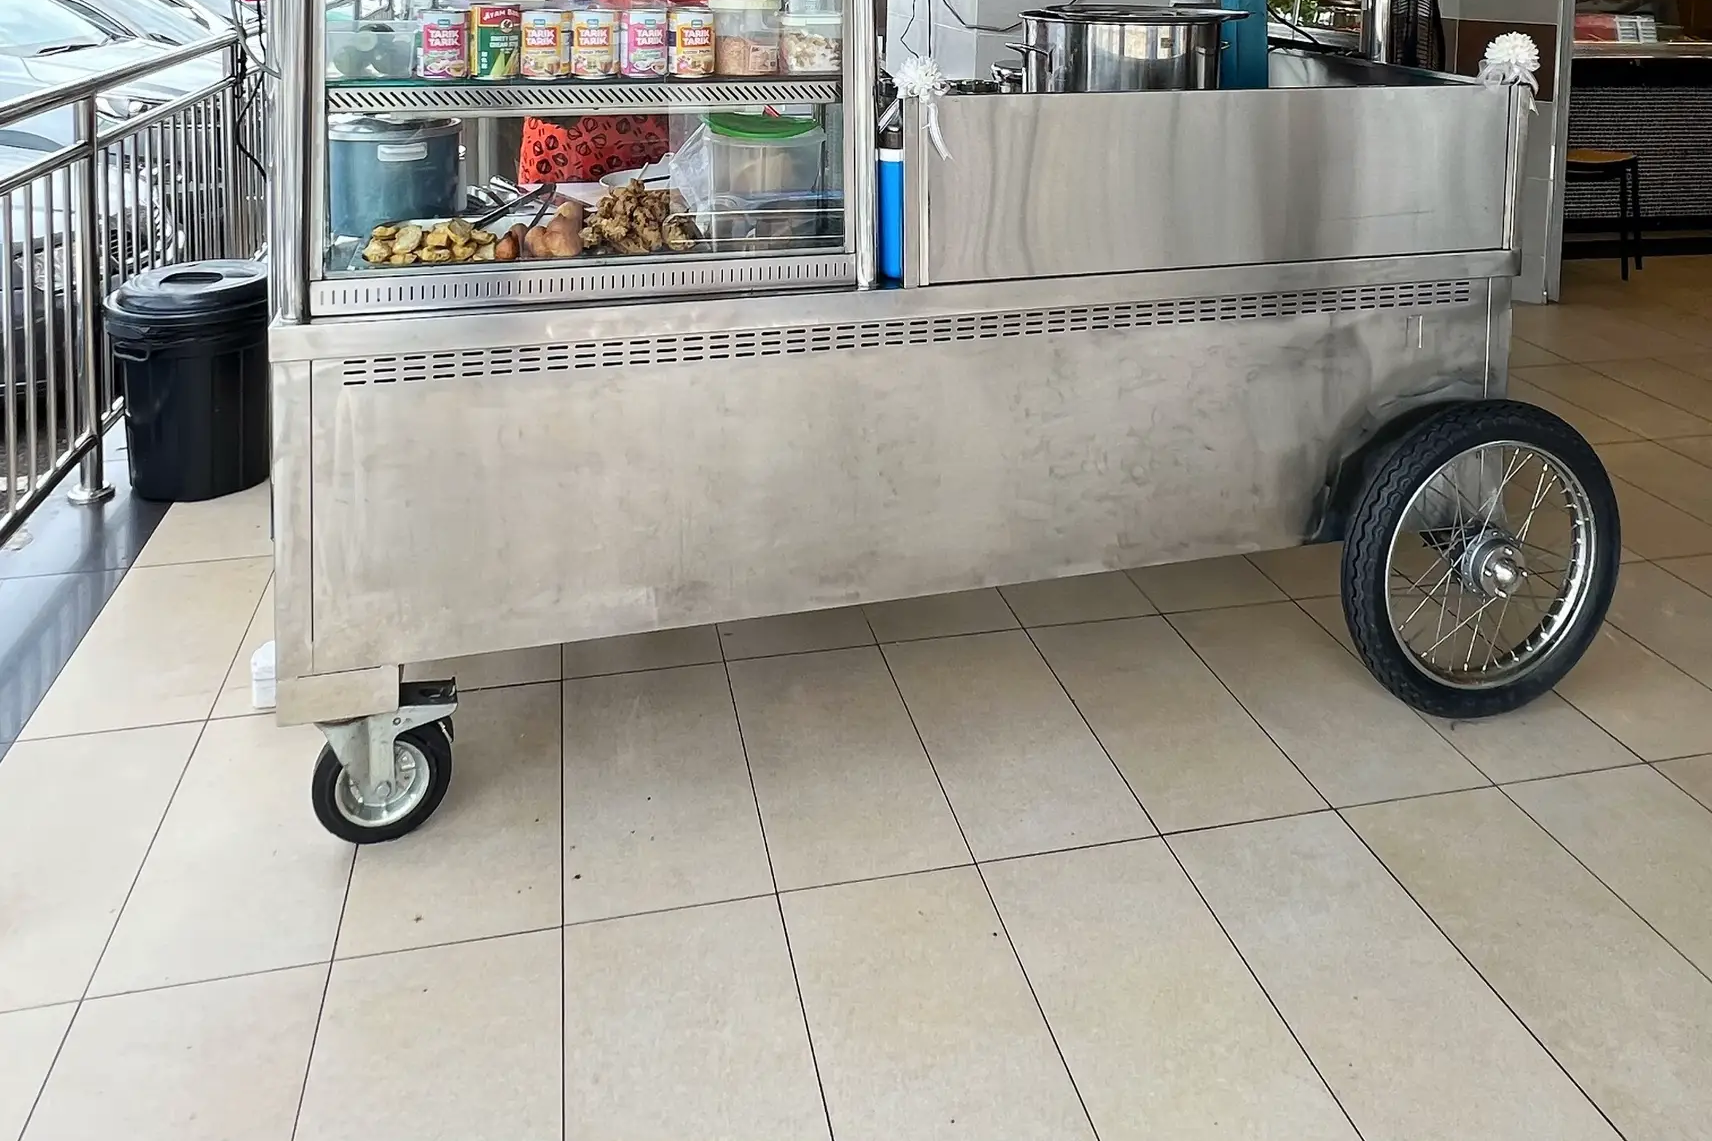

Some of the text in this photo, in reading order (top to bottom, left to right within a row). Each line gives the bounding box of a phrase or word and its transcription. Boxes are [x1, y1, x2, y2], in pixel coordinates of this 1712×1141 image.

[427, 29, 460, 38] TARIK
[525, 28, 555, 38] TARIK
[577, 28, 608, 38] TARIK
[634, 29, 663, 38] TARIK
[682, 29, 710, 38] TARIK
[428, 38, 461, 47] TARIK
[526, 37, 556, 46] TARIK
[578, 37, 609, 46] TARIK
[635, 37, 664, 46] TARIK
[682, 37, 711, 46] TARIK
